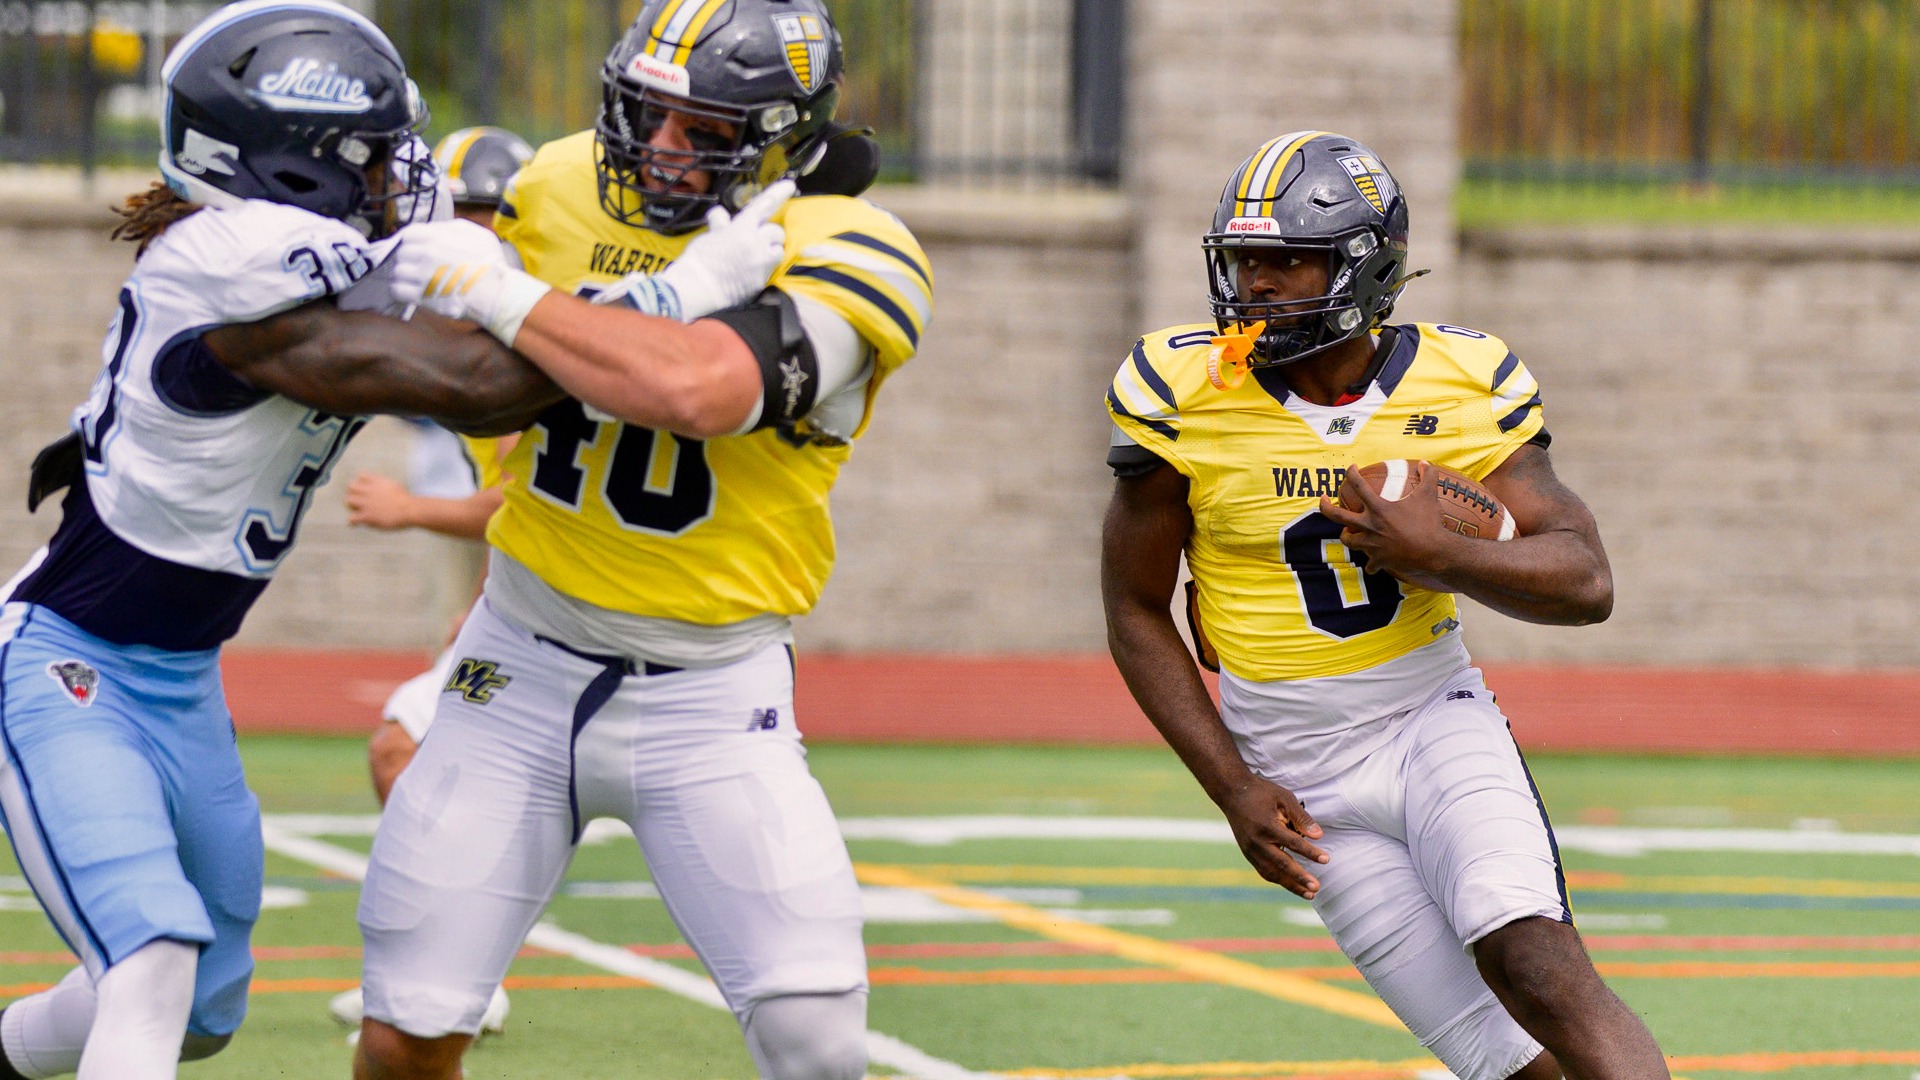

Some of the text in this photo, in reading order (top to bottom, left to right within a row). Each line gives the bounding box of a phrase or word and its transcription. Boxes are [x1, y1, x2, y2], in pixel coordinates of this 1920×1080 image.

[252, 57, 372, 112] Maine
[1229, 221, 1272, 232] Riddell
[1326, 416, 1356, 435] MC
[1278, 507, 1407, 642] 0
[443, 657, 513, 705] MC
